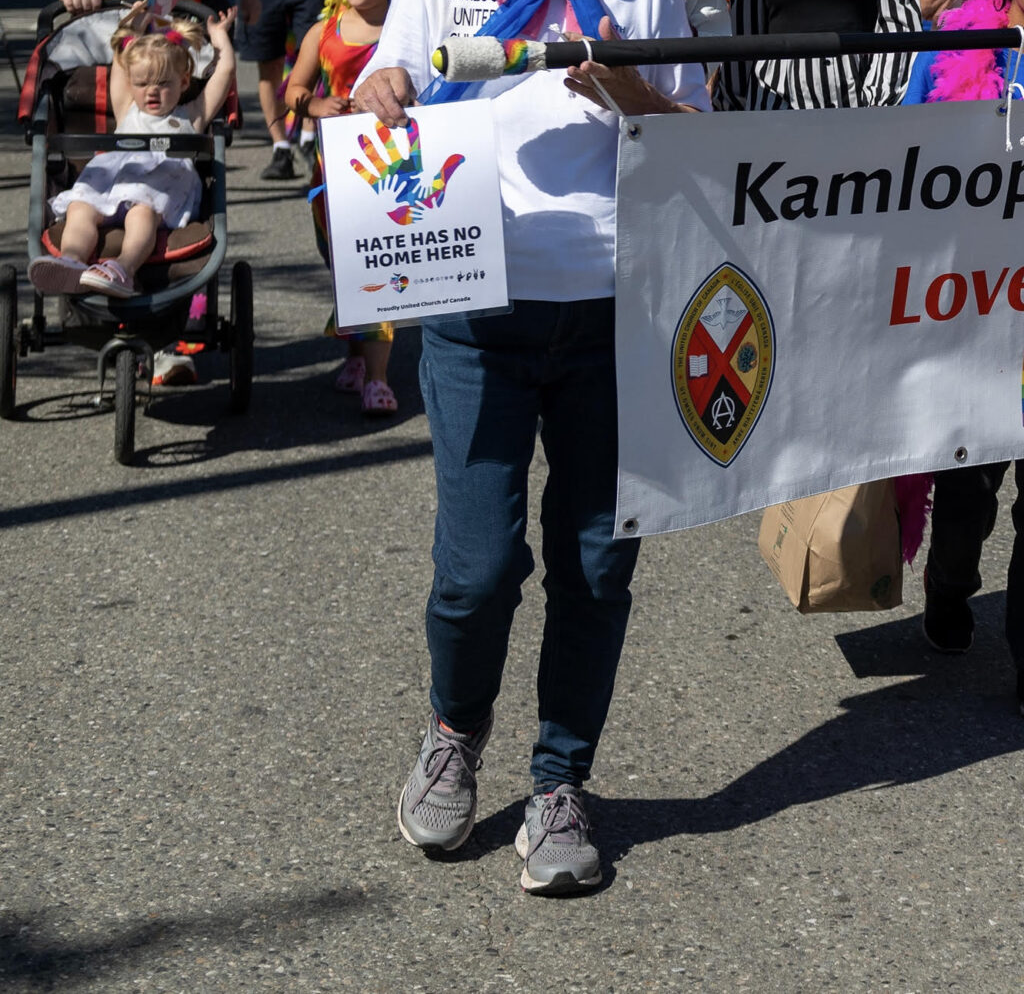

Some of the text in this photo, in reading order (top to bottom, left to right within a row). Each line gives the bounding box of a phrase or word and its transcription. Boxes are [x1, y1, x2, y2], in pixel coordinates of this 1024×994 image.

[355, 225, 482, 253] HATE HAS NO
[365, 243, 476, 269] HOME HERE
[376, 305, 400, 313] Proudly
[400, 302, 420, 310] United
[421, 299, 442, 307] Church
[449, 296, 471, 304] Canada
